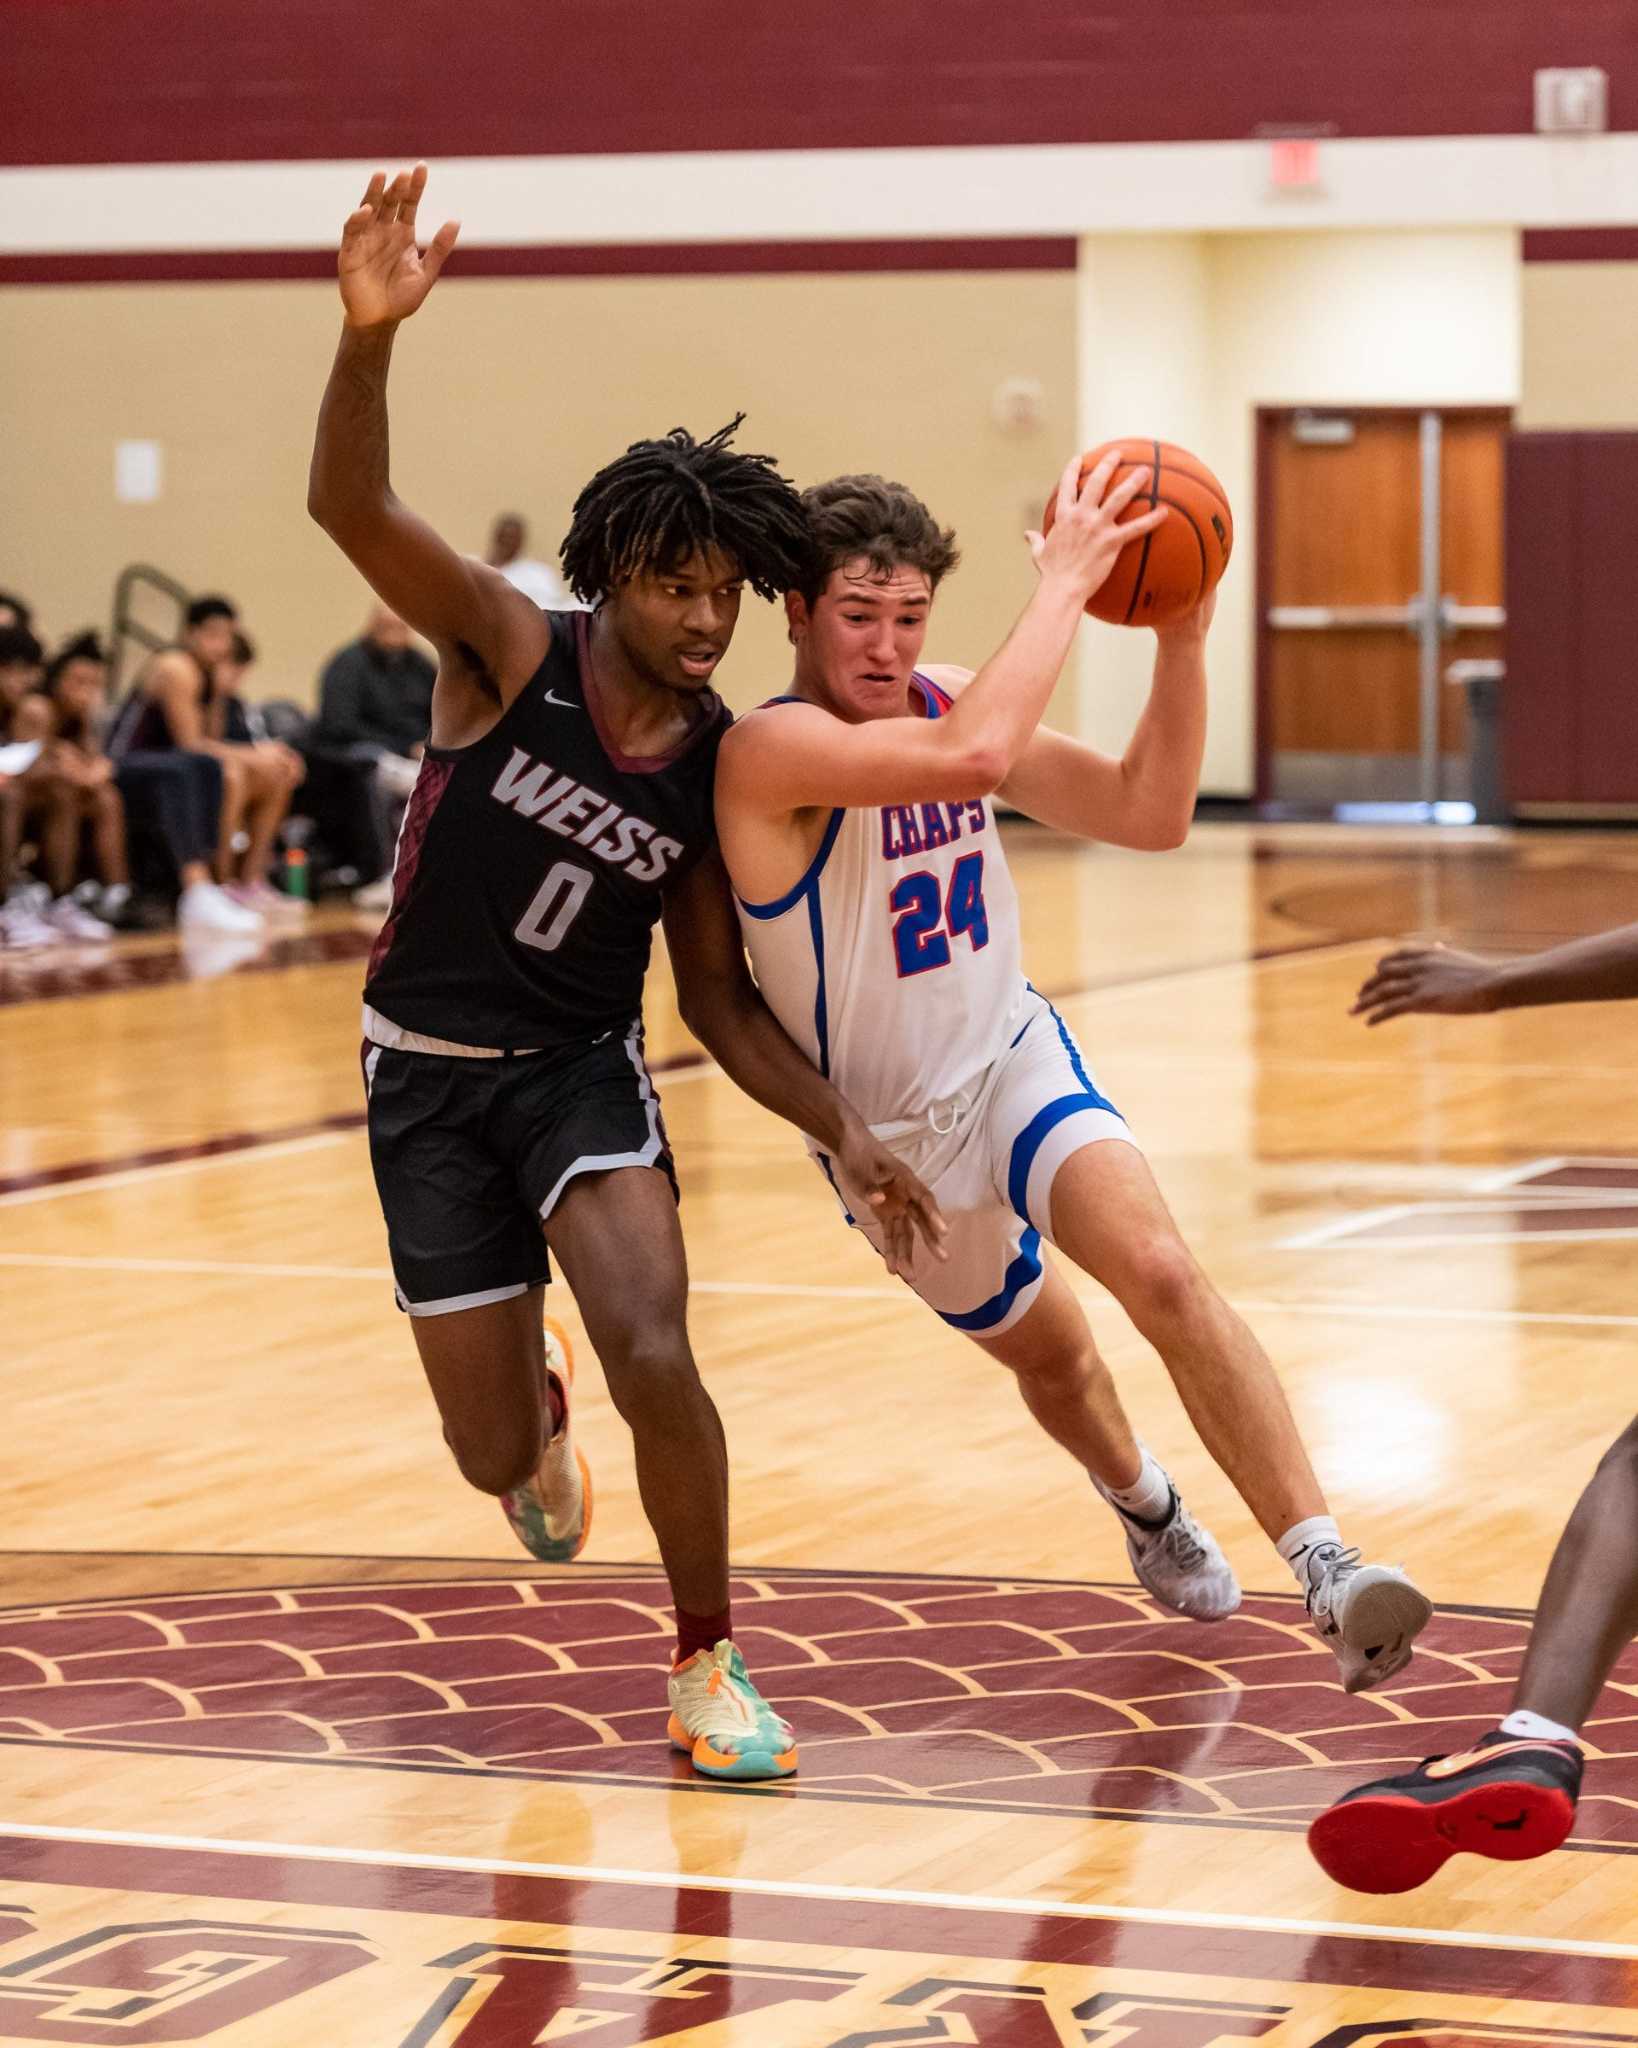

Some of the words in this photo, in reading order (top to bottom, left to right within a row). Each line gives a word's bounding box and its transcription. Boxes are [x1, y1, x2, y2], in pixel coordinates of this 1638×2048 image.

[490, 745, 685, 883] WEISS
[513, 860, 595, 951] 0
[889, 849, 990, 979] 24
